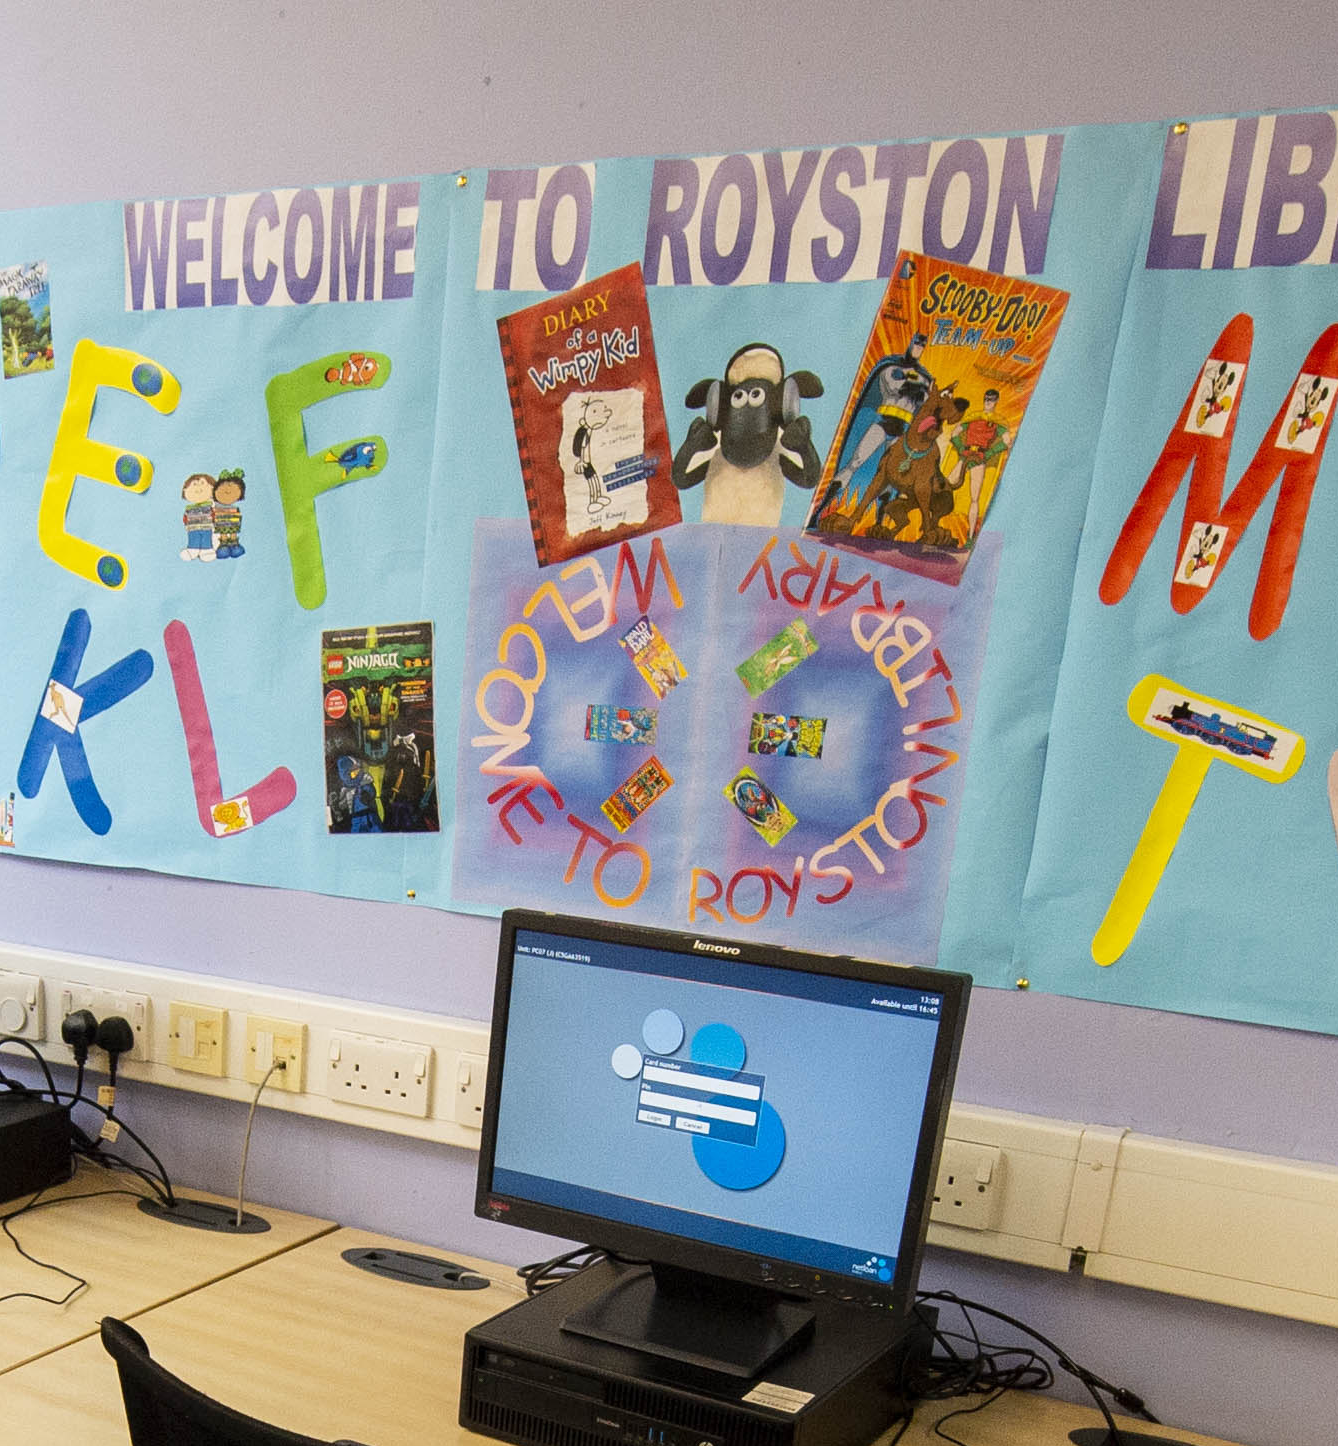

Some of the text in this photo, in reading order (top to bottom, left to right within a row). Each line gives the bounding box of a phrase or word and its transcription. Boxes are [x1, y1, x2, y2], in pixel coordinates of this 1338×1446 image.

[126, 182, 419, 310] WELCOME
[484, 163, 594, 291] TO
[645, 135, 1063, 286] ROYSTON
[543, 290, 611, 336] DIARY
[566, 328, 598, 349] of a
[528, 325, 639, 397] Wimpy Kid
[38, 339, 182, 591] E
[265, 351, 393, 609] F
[346, 652, 401, 673] NINJAGO
[17, 608, 154, 835] K
[163, 619, 297, 838] L
[1092, 674, 1306, 966] T
[564, 814, 651, 909] TO
[692, 939, 741, 956] lenovo
[870, 997, 902, 1010] Available
[901, 1003, 918, 1012] until
